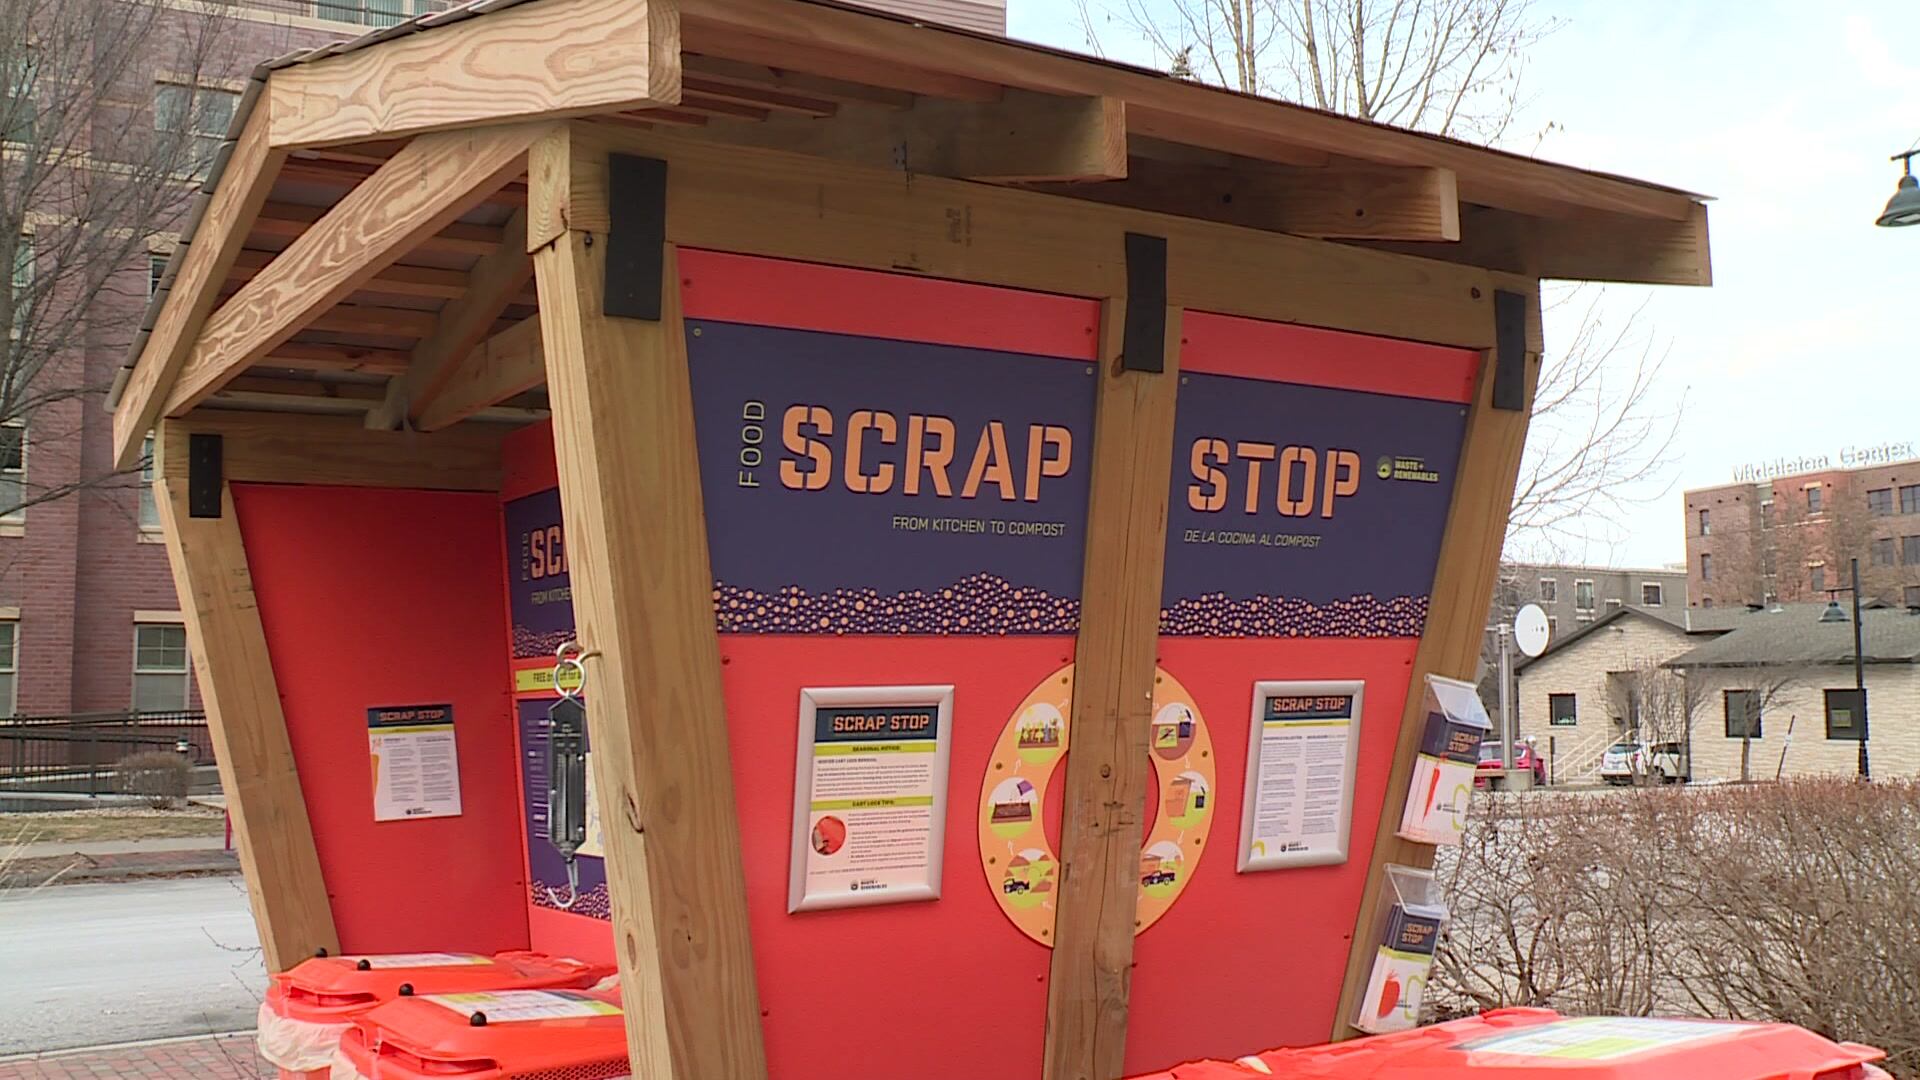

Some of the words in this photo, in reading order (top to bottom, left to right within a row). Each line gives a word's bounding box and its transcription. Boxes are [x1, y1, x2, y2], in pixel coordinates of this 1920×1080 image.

[738, 400, 765, 487] FOOD
[778, 404, 1073, 502] SCRAP
[1187, 438, 1361, 518] STOP
[892, 516, 928, 531] FROM
[932, 519, 985, 533] KITCHEN
[990, 521, 1005, 534] TO
[1008, 522, 1065, 536] COMPOST
[1184, 529, 1199, 543] DE
[1201, 531, 1215, 543] LA
[1217, 531, 1256, 545] COCINA
[1259, 534, 1272, 546] AL
[1274, 534, 1321, 548] COMPOST
[1273, 697, 1313, 712] SCRAP
[1315, 697, 1346, 711] STOP
[379, 711, 416, 721] SCRAP
[417, 709, 445, 720] STOP
[834, 716, 886, 732] SCRAP
[890, 715, 929, 730] STOP
